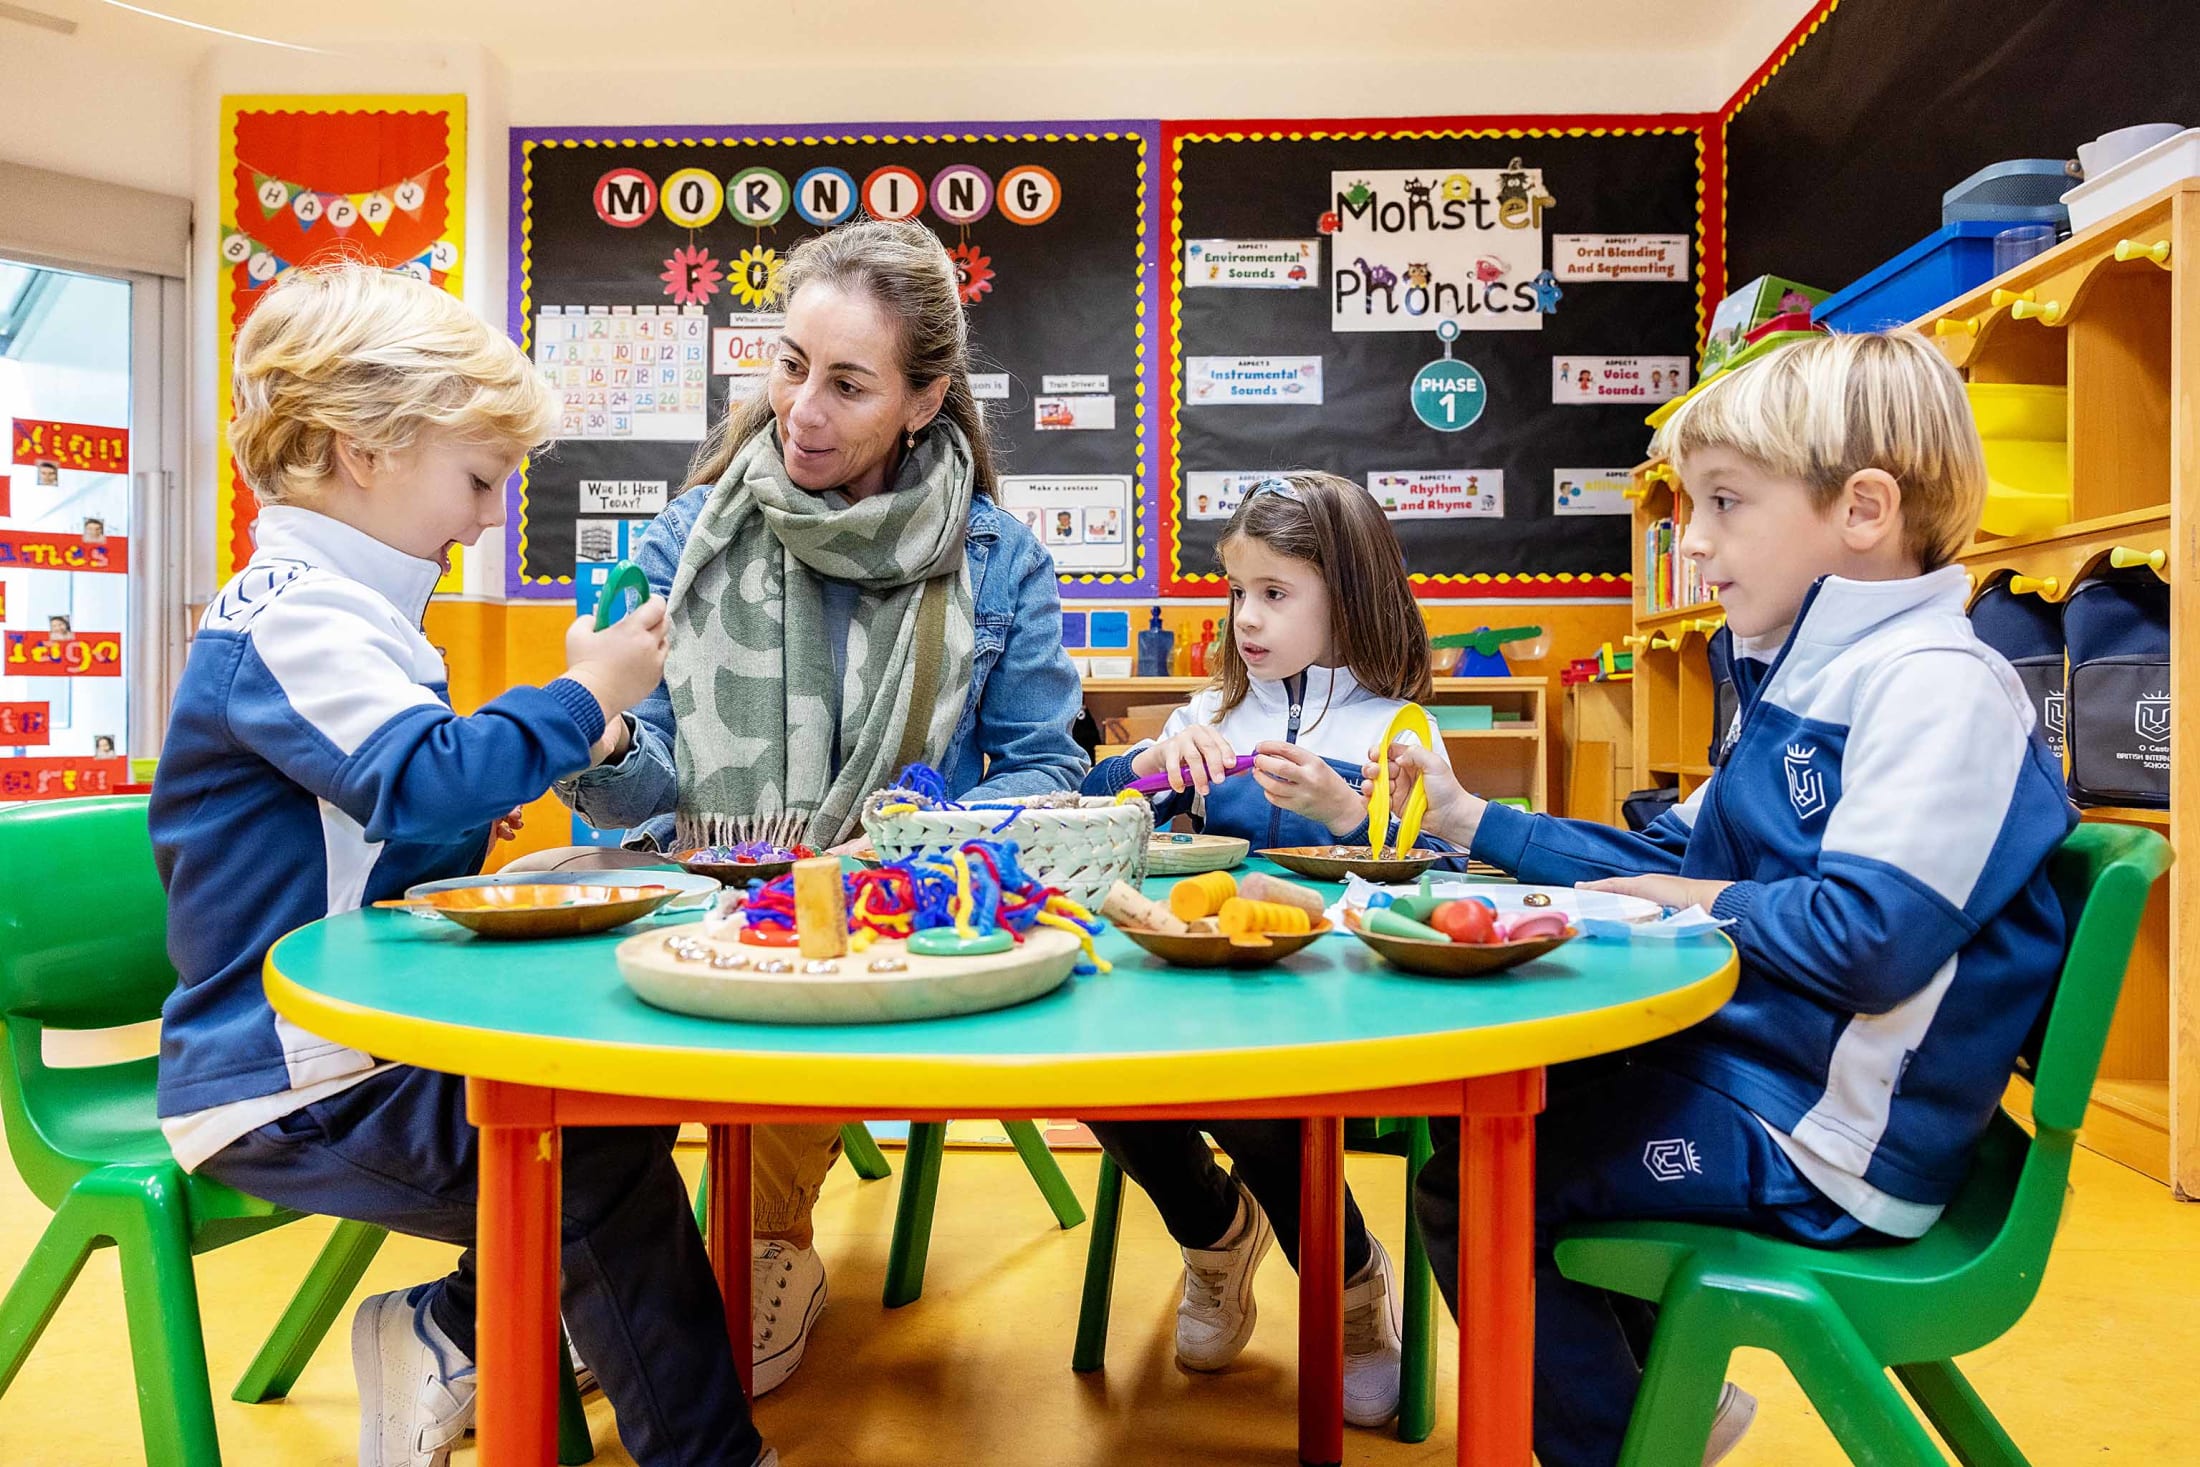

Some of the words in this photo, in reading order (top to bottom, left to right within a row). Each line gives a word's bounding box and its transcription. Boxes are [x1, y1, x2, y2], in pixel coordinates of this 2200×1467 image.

[264, 187, 414, 222] HAPPY
[607, 180, 1042, 215] MORNING
[1337, 187, 1556, 233] Monster
[1204, 252, 1300, 263] Environmental
[1577, 247, 1605, 258] Oral
[1607, 246, 1666, 261] Blending
[1228, 268, 1275, 279] Sounds
[1567, 263, 1595, 274] And
[1597, 262, 1675, 278] Segmenting
[1336, 269, 1537, 315] Phonics
[615, 345, 628, 359] 10
[641, 347, 649, 360] 11
[660, 346, 674, 360] 12
[687, 347, 701, 360] 13
[729, 337, 781, 359] Octo
[591, 369, 603, 382] 16
[614, 369, 627, 383] 17
[636, 369, 649, 384] 18
[662, 369, 675, 383] 19
[686, 370, 702, 382] 20
[1211, 369, 1298, 379] Instrumental
[1603, 369, 1640, 380] Voice
[1231, 385, 1277, 396] Sounds
[1421, 378, 1477, 392] PHASE
[1598, 385, 1645, 396] Sounds
[565, 392, 581, 405] 22
[588, 393, 605, 405] 23
[611, 393, 627, 405] 24
[635, 394, 653, 405] 25
[659, 393, 676, 405] 26
[1439, 393, 1455, 422] 1
[564, 416, 580, 429] 29
[588, 415, 605, 428] 30
[615, 416, 627, 430] 31
[1410, 484, 1461, 496] Rhythm
[1400, 500, 1424, 510] and
[1428, 500, 1472, 512] Rhyme
[2139, 744, 2146, 752] O
[0, 760, 108, 794] aria
